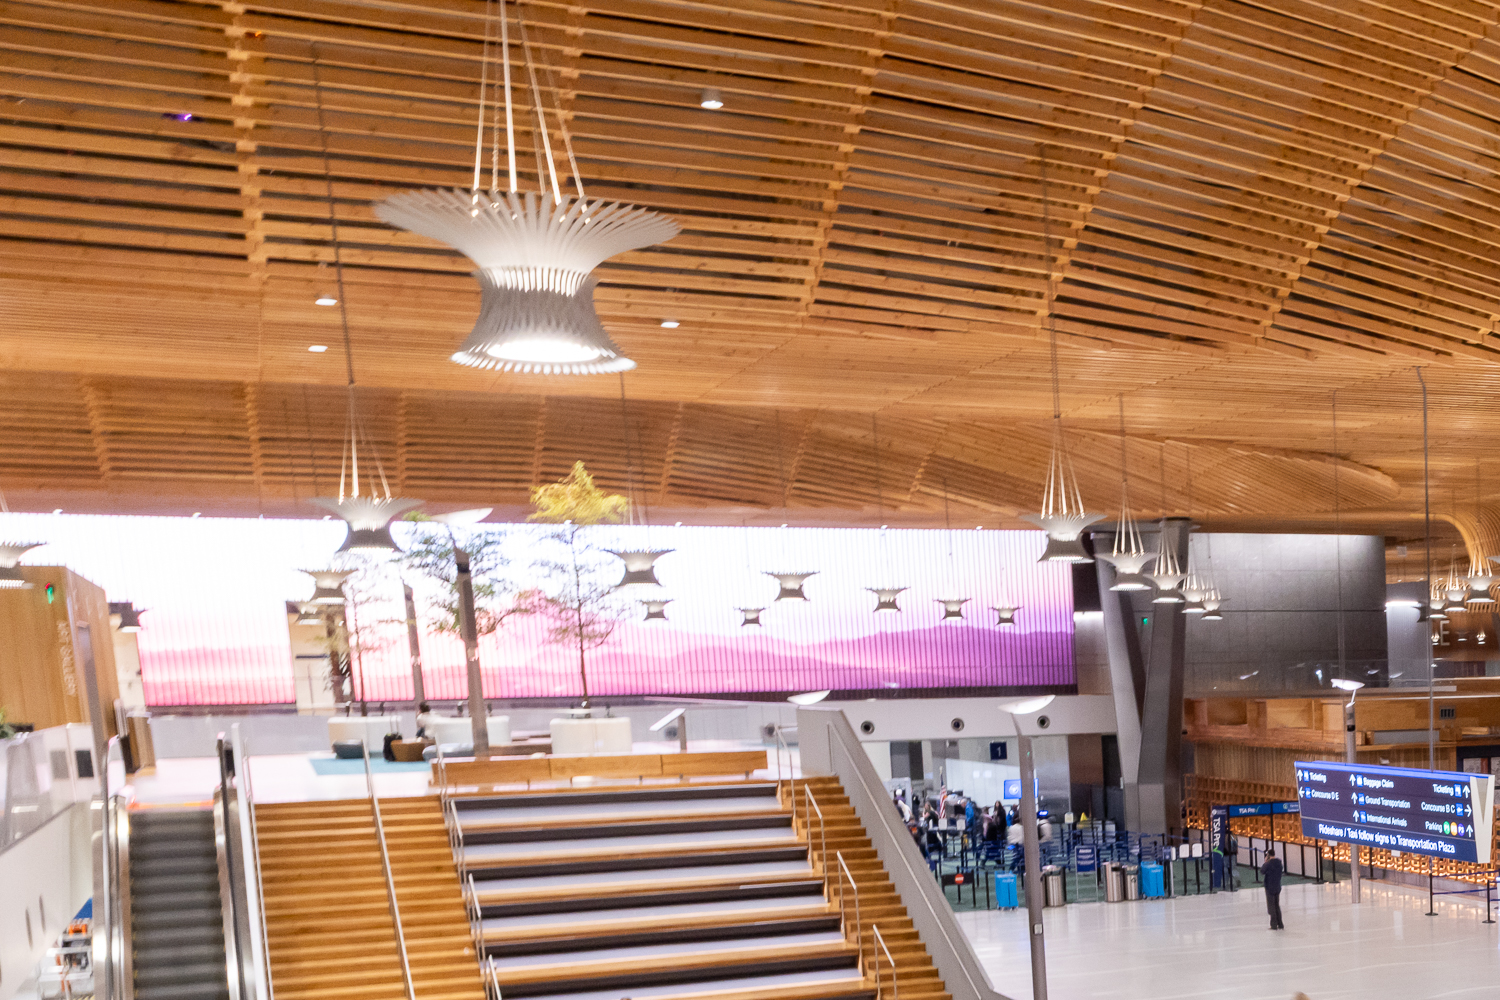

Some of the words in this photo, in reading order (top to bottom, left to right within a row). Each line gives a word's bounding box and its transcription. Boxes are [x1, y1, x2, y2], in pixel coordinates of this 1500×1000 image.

[1309, 772, 1327, 783] Ticketing
[1363, 777, 1381, 789] Baggage
[1381, 778, 1395, 788] Claim
[1311, 789, 1331, 800] Concourse
[1331, 791, 1335, 800] D
[1335, 791, 1340, 801] E
[1432, 783, 1454, 796] Ticketing
[1365, 795, 1381, 805] Ground
[1381, 796, 1411, 808] Transportation
[1421, 801, 1445, 813] Concourse
[1445, 804, 1450, 814] B
[1450, 804, 1455, 814] C
[1213, 817, 1221, 833] TSA
[1366, 813, 1391, 825] International
[1391, 816, 1408, 827] Arrivals
[1425, 821, 1443, 833] Parking
[1213, 833, 1221, 847] Pre
[1318, 823, 1344, 837] Rideshare
[1347, 827, 1358, 839] Taxi
[1358, 829, 1374, 841] follow
[1374, 832, 1390, 845] signs
[1390, 834, 1397, 845] to
[1396, 834, 1438, 851] Transportation
[1438, 840, 1456, 854] Plaza
